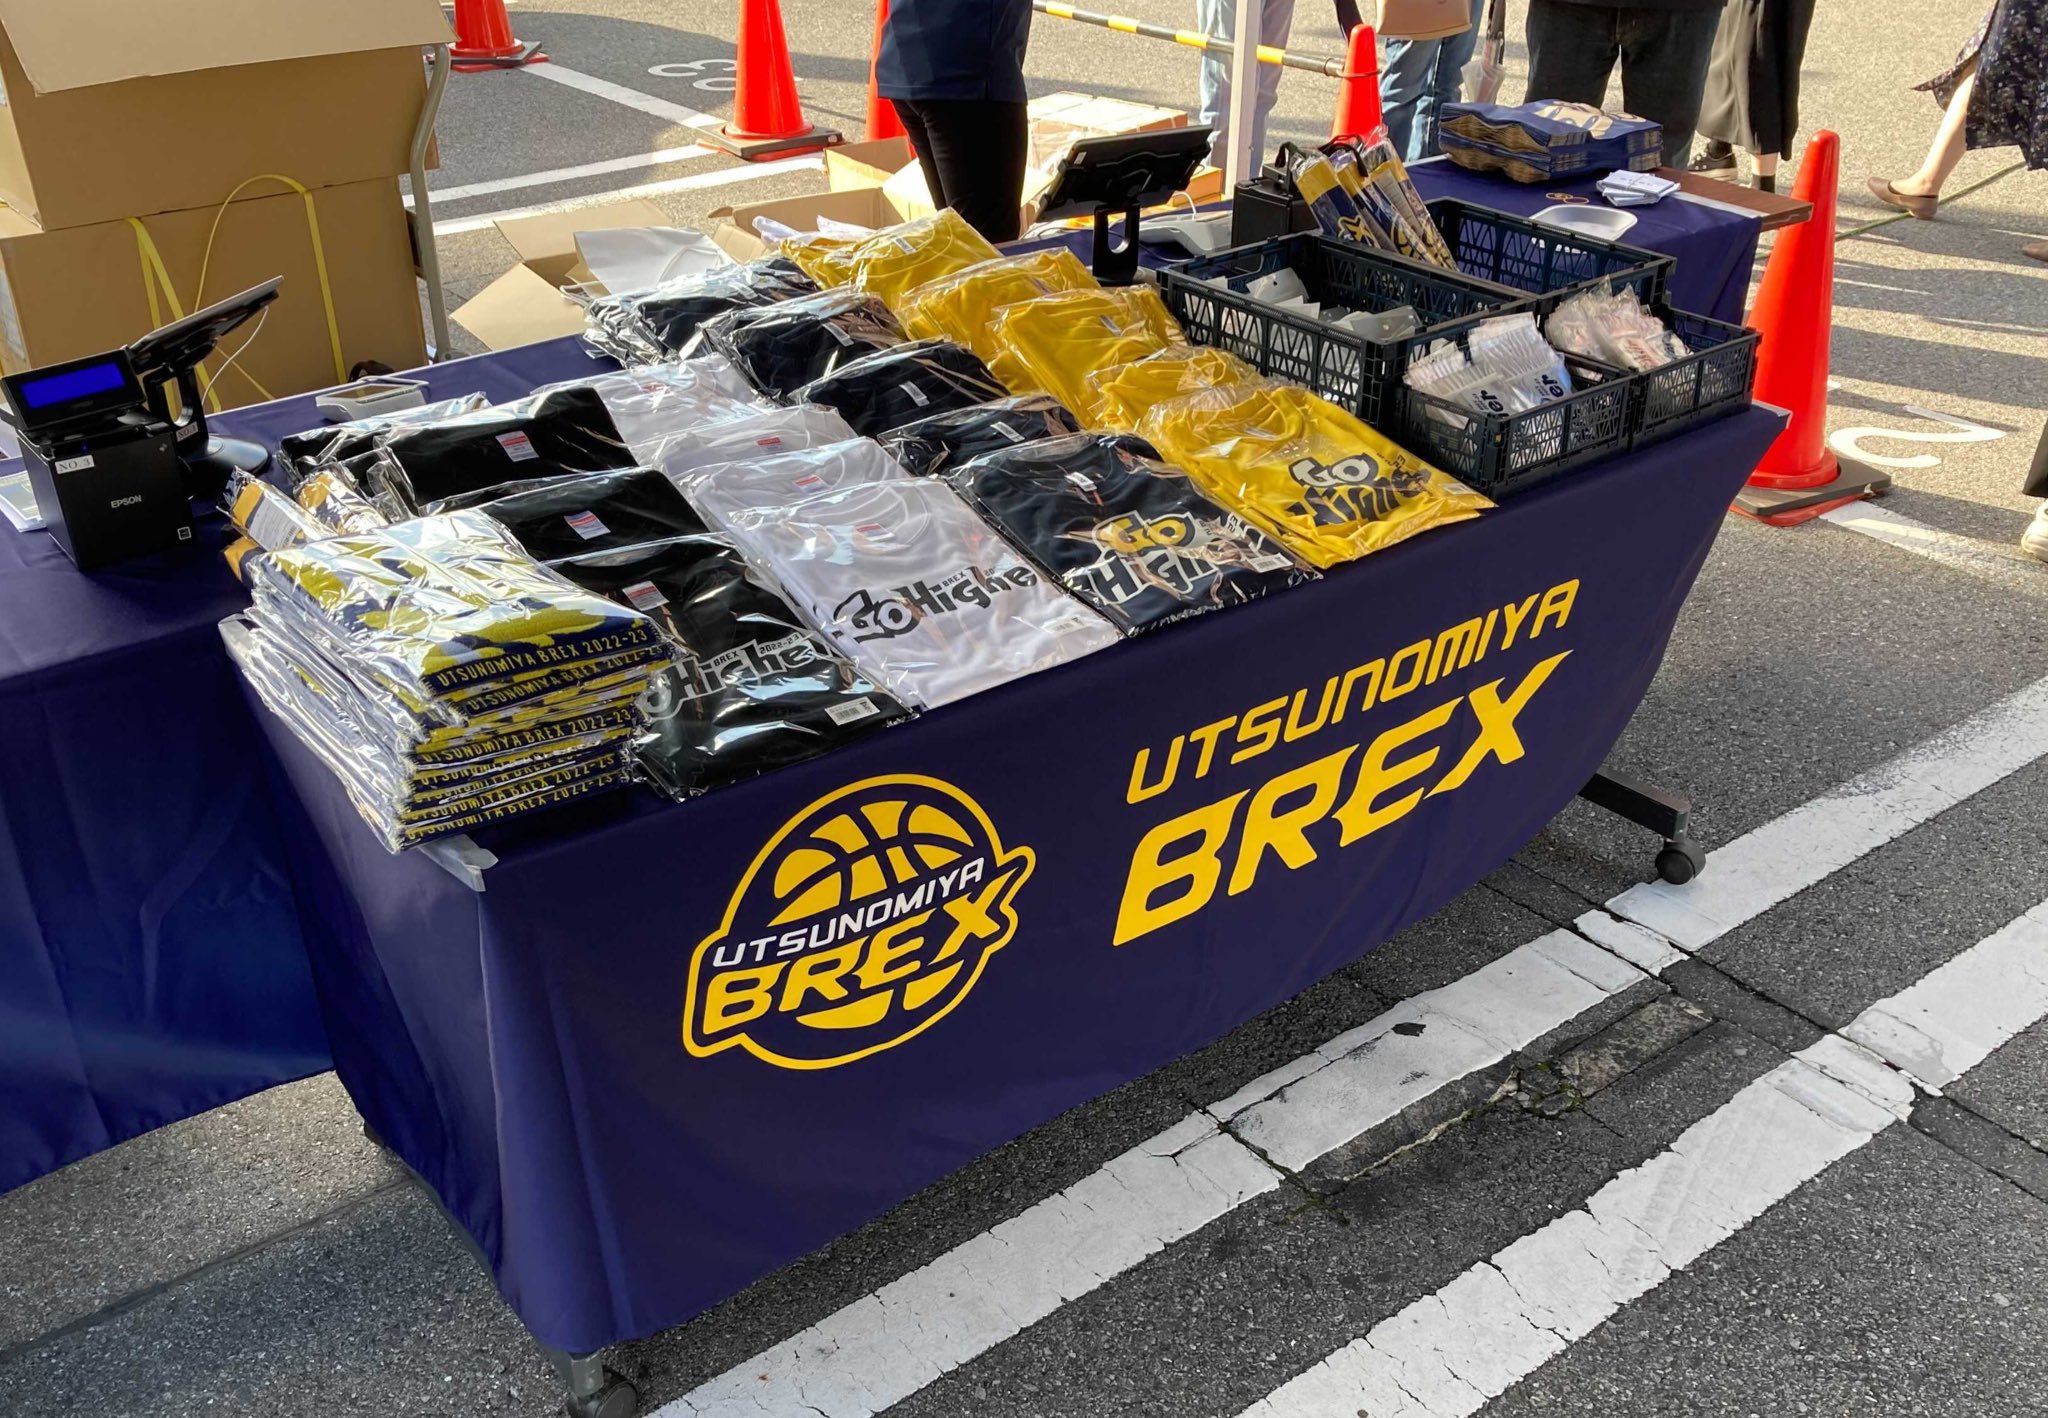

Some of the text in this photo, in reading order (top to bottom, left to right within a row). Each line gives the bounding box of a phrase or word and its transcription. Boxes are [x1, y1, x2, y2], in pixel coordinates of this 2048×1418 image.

[111, 495, 142, 508] EPSON
[437, 627, 648, 687] UTSUNOMIYA BREX 2022-23
[467, 672, 558, 711] UTSUNOMIYA
[560, 663, 600, 687] BREX
[713, 651, 739, 667] BREX
[1126, 578, 1580, 805] UTSUNOMIYA
[422, 734, 521, 763] UTSUNOMIYA
[526, 724, 565, 743] BREX
[569, 708, 632, 732] 2022-23
[1113, 649, 1574, 946] BREX
[712, 857, 985, 967] UTSUNOMIYA
[703, 867, 1019, 1035] BREX
